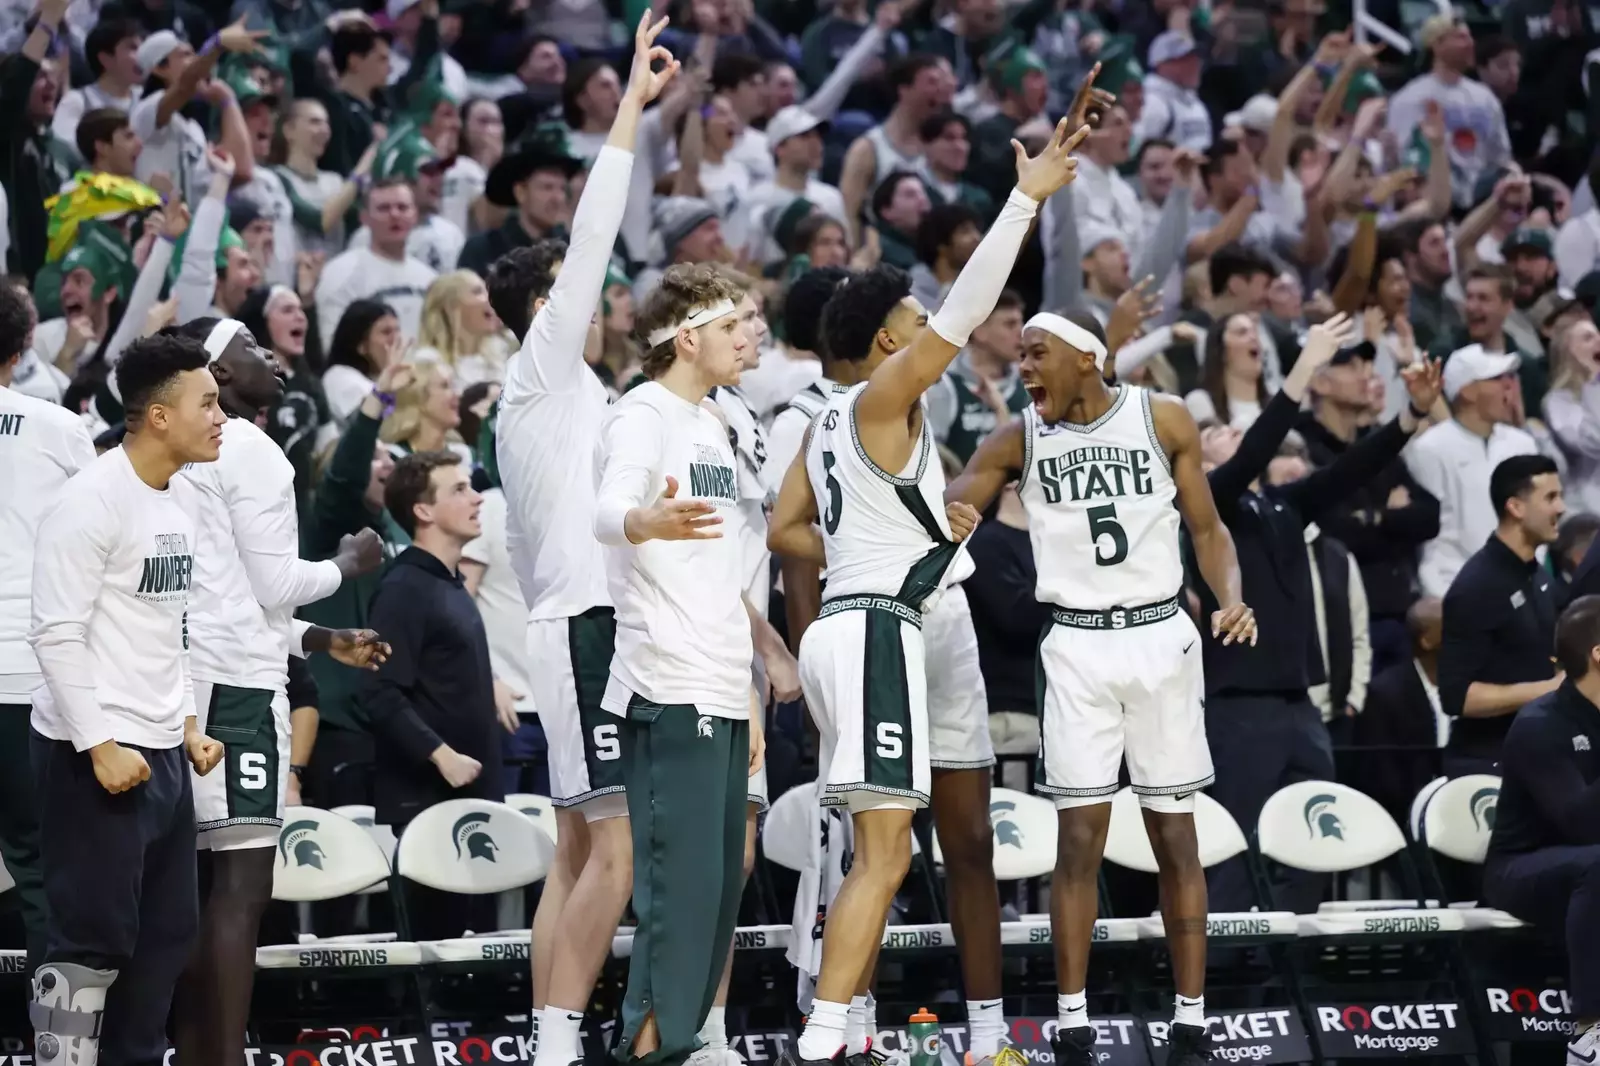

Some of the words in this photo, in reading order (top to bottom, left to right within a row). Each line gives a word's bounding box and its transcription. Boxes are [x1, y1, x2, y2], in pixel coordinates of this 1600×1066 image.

[0, 414, 25, 436] NT
[1059, 446, 1129, 471] MICHIGAN
[1037, 449, 1153, 504] STATE
[1086, 502, 1129, 567] 5
[1111, 610, 1126, 629] S
[593, 723, 621, 761] S
[876, 721, 903, 760] S
[240, 752, 267, 790] S
[1364, 916, 1440, 932] SPARTANS
[299, 949, 388, 967] SPARTANS
[1147, 1010, 1290, 1047] RCKET
[1317, 1003, 1458, 1032] ROCKET
[1354, 1034, 1439, 1051] Mortgage
